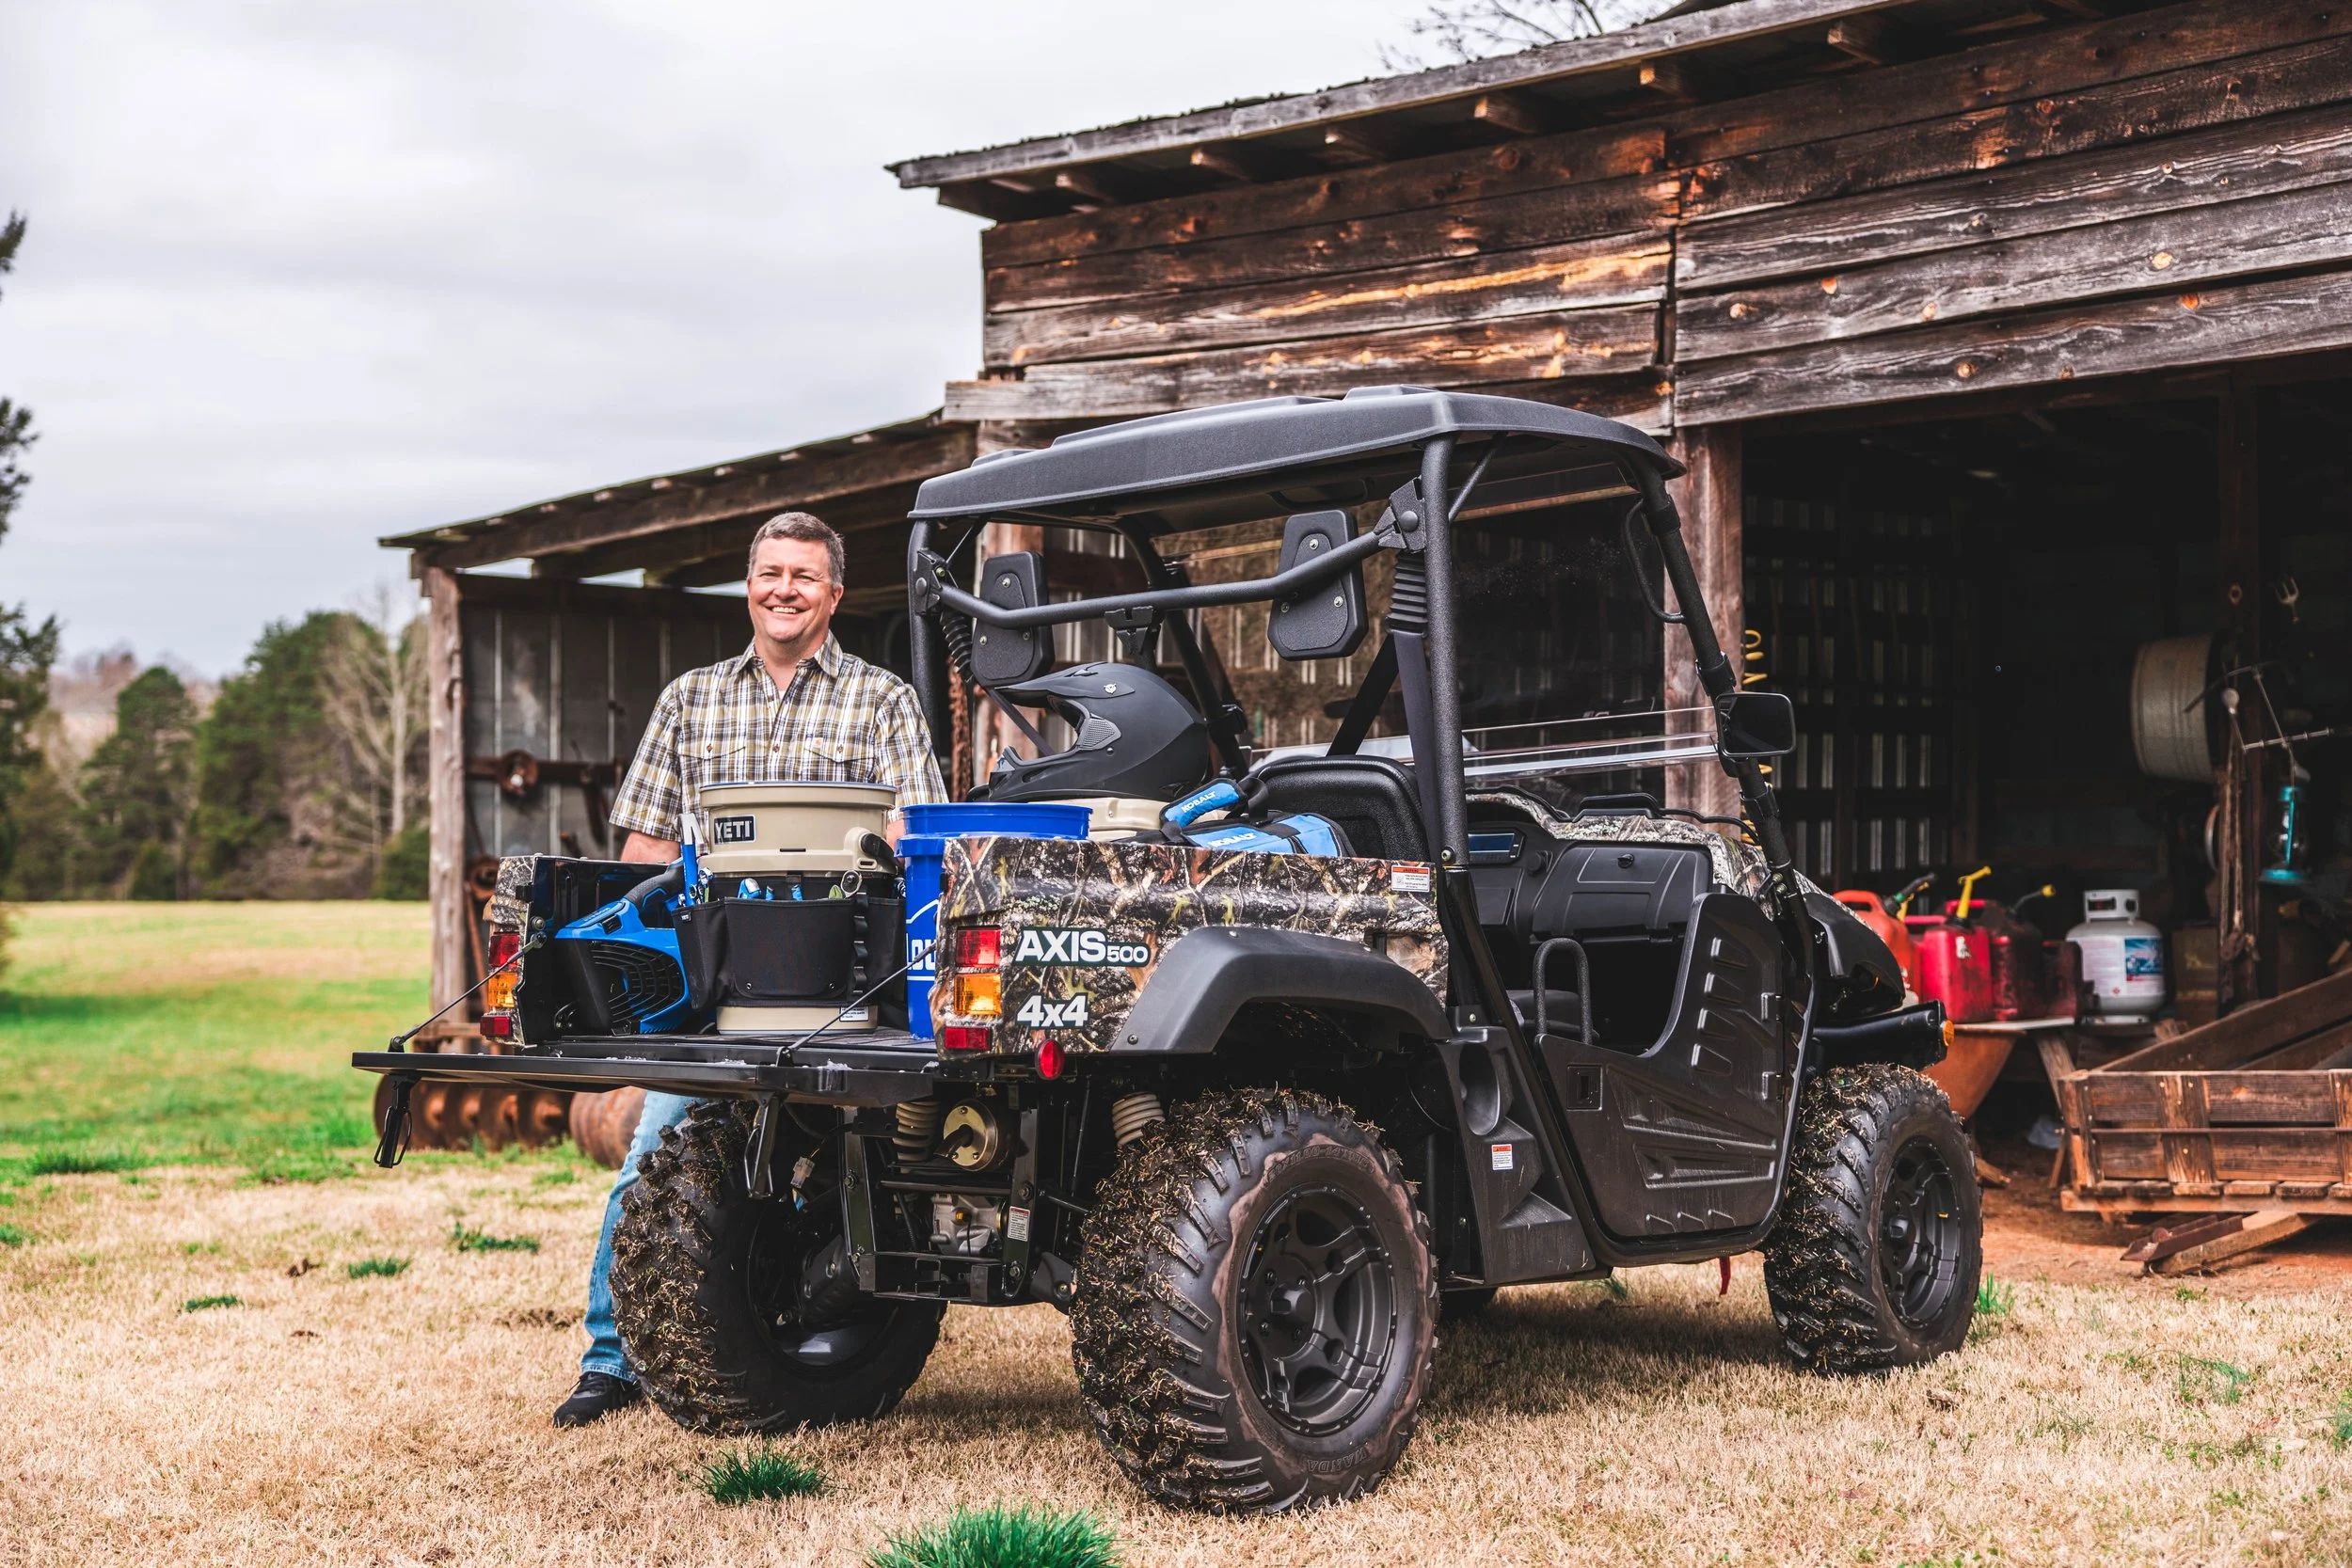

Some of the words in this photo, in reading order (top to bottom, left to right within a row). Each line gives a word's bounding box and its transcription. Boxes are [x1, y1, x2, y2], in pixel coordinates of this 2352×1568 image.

[1181, 791, 1216, 814] KOBALT
[715, 820, 751, 839] YETI
[1017, 995, 1089, 1027] 4x4
